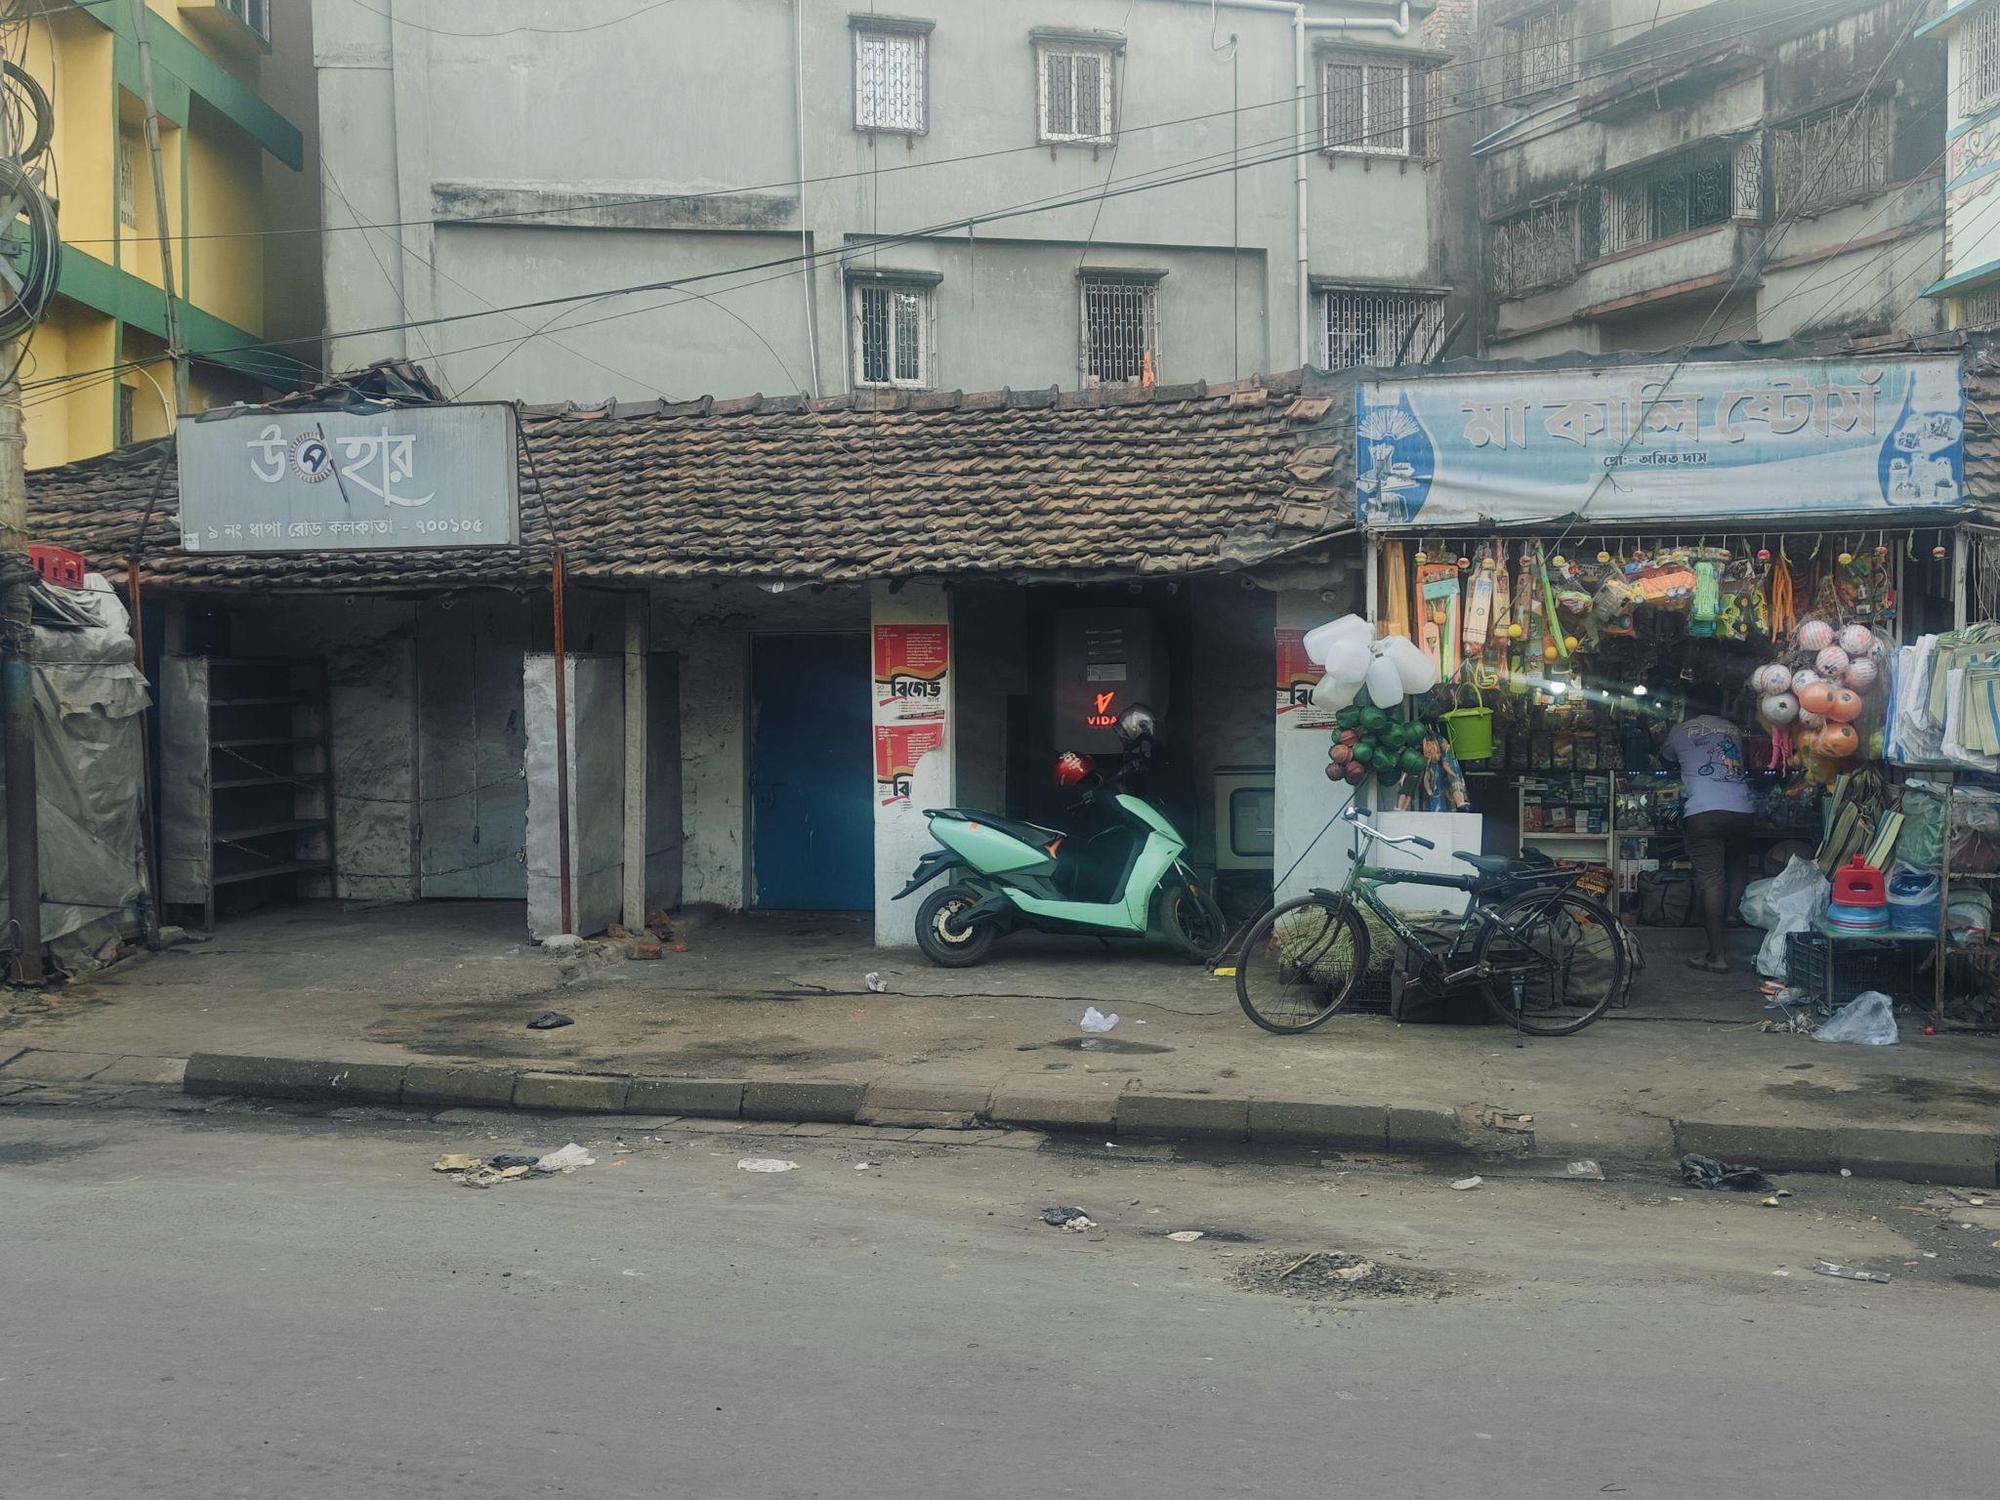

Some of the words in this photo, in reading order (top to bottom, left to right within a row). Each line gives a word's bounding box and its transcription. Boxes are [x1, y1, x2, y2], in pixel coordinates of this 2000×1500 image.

[1459, 400, 1531, 450] মা
[1542, 378, 1704, 447] কালি
[1639, 450, 1679, 464] অমিত
[1681, 452, 1707, 463] দাস
[223, 523, 243, 540] নং
[288, 519, 323, 537] রোড
[327, 518, 393, 535] কলকাতা
[416, 518, 484, 534] ৭০০১০৫
